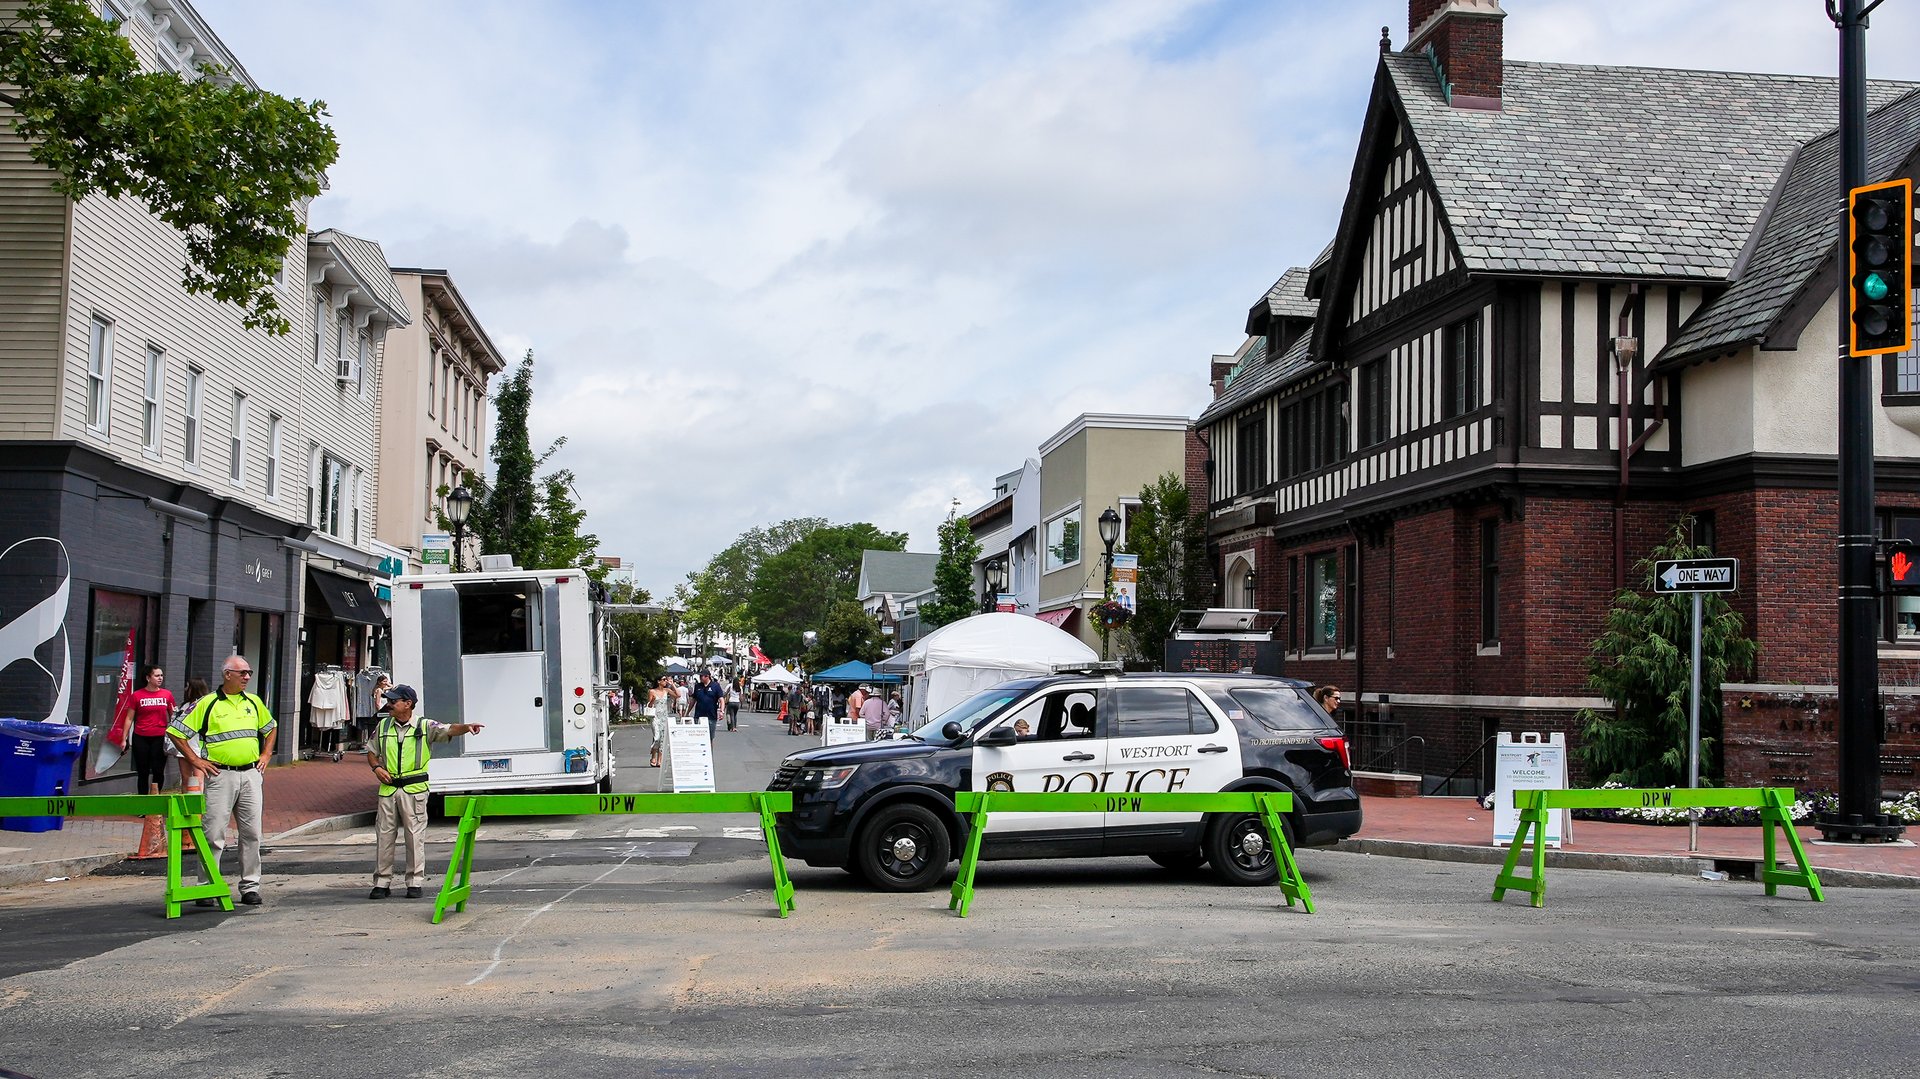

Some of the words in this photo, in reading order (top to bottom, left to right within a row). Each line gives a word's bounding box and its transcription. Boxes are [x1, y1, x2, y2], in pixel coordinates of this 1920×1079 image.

[245, 564, 254, 575] LOU
[1678, 569, 1699, 581] ONE
[1703, 568, 1727, 581] WAY
[140, 697, 168, 707] CORNELL
[1120, 745, 1192, 759] WESTPORT
[987, 773, 1013, 782] POLICE
[1041, 767, 1191, 792] POLICE
[599, 796, 635, 812] DPW
[1106, 797, 1142, 812] DPW
[1642, 792, 1671, 807] DPW
[47, 799, 76, 816] DPW
